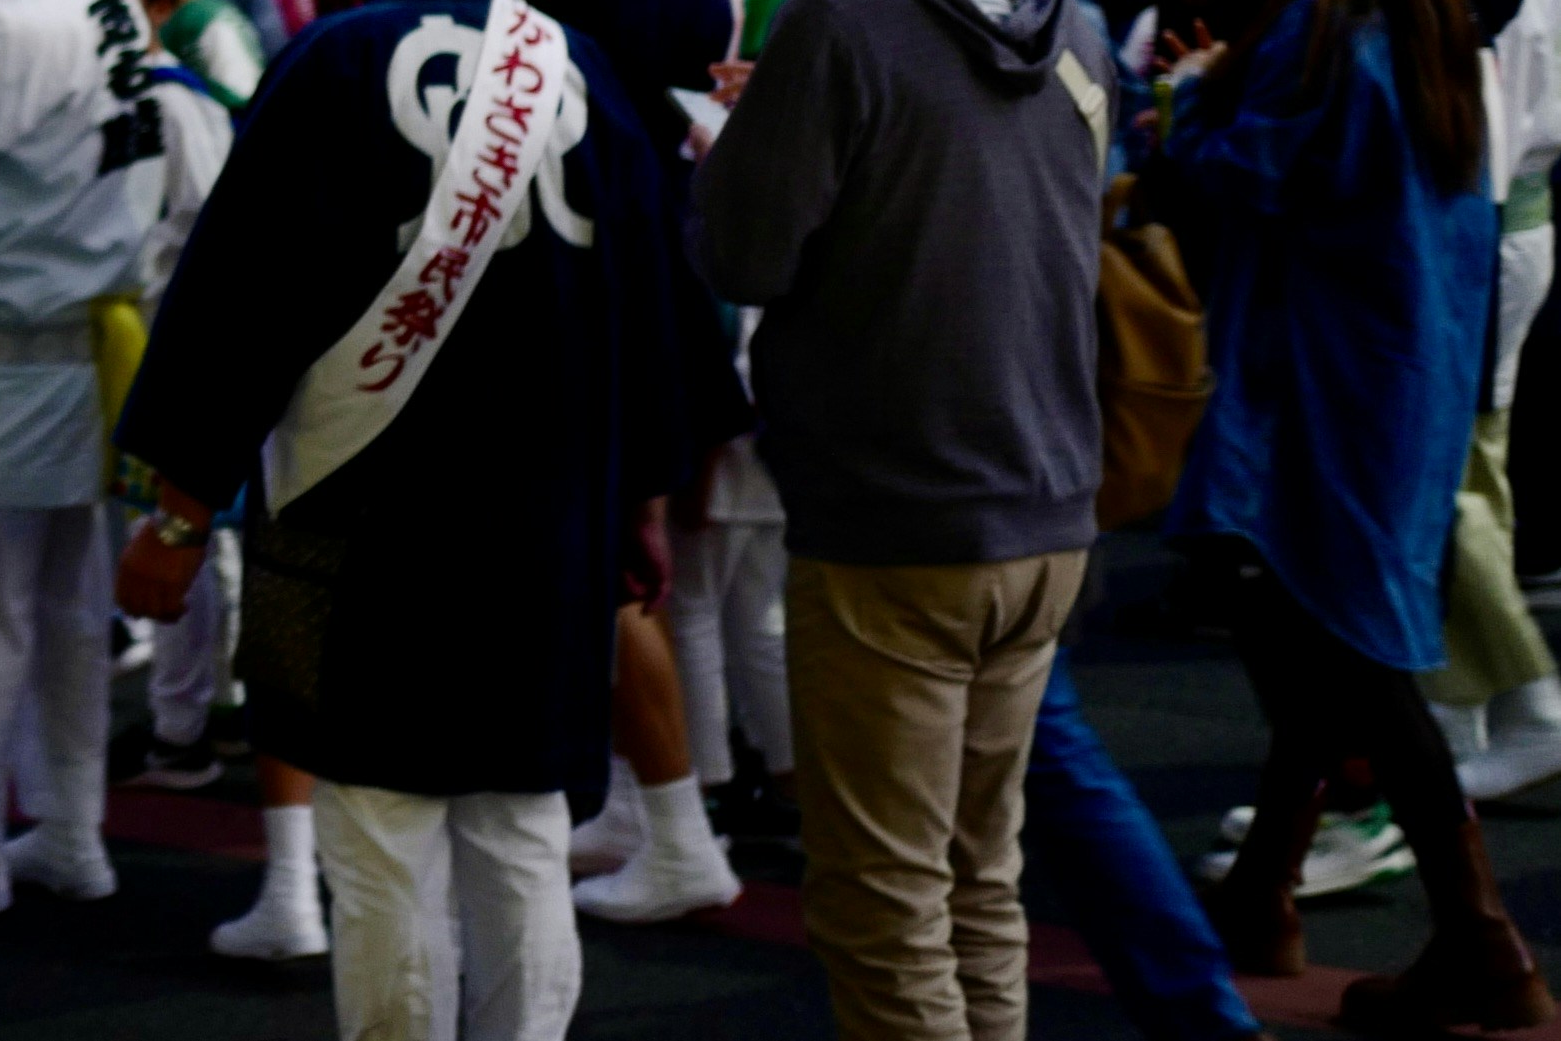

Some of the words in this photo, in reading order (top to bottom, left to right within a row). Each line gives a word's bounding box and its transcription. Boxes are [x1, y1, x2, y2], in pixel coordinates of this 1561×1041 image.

[356, 5, 553, 393] かわさき市民祭り
